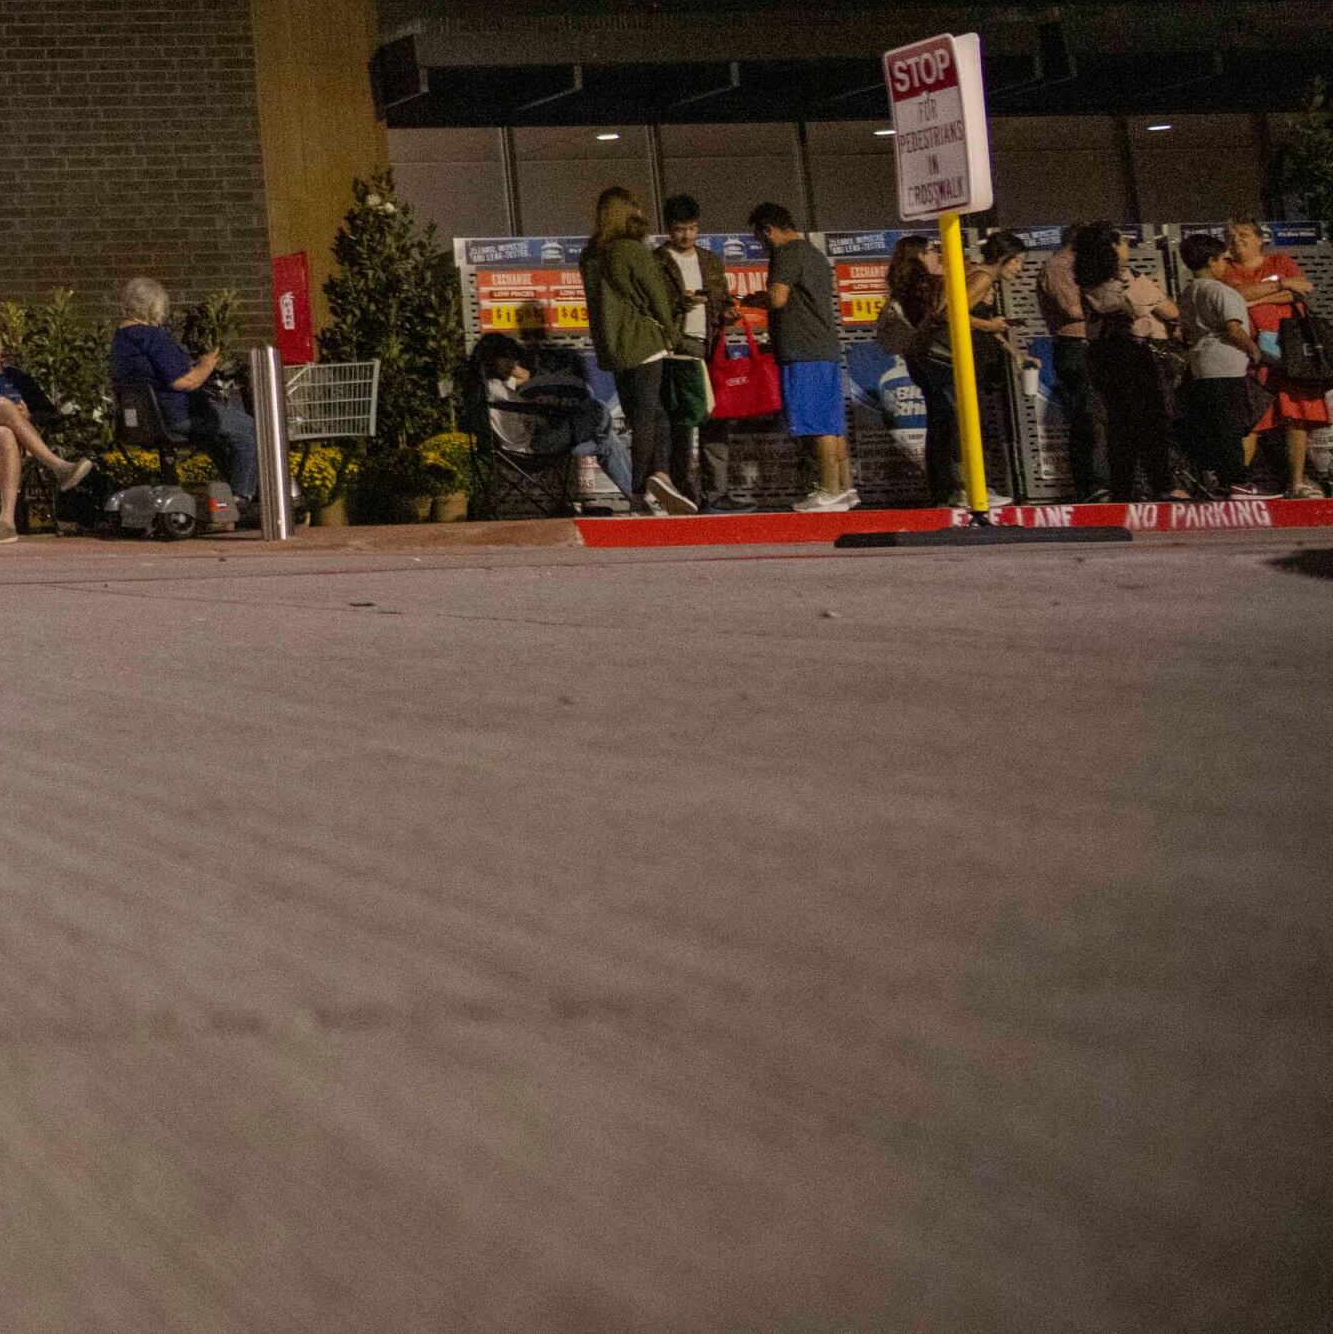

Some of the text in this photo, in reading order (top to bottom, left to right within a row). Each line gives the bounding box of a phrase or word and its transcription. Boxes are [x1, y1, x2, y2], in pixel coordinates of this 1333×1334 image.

[892, 48, 950, 93] STOP
[918, 99, 938, 122] FOR
[899, 120, 965, 154] PEDESTRIANS
[928, 154, 939, 176] IN
[908, 176, 965, 207] CROSSWALK
[493, 273, 531, 284] EXCHANGE
[1126, 500, 1271, 528] NO PARKING
